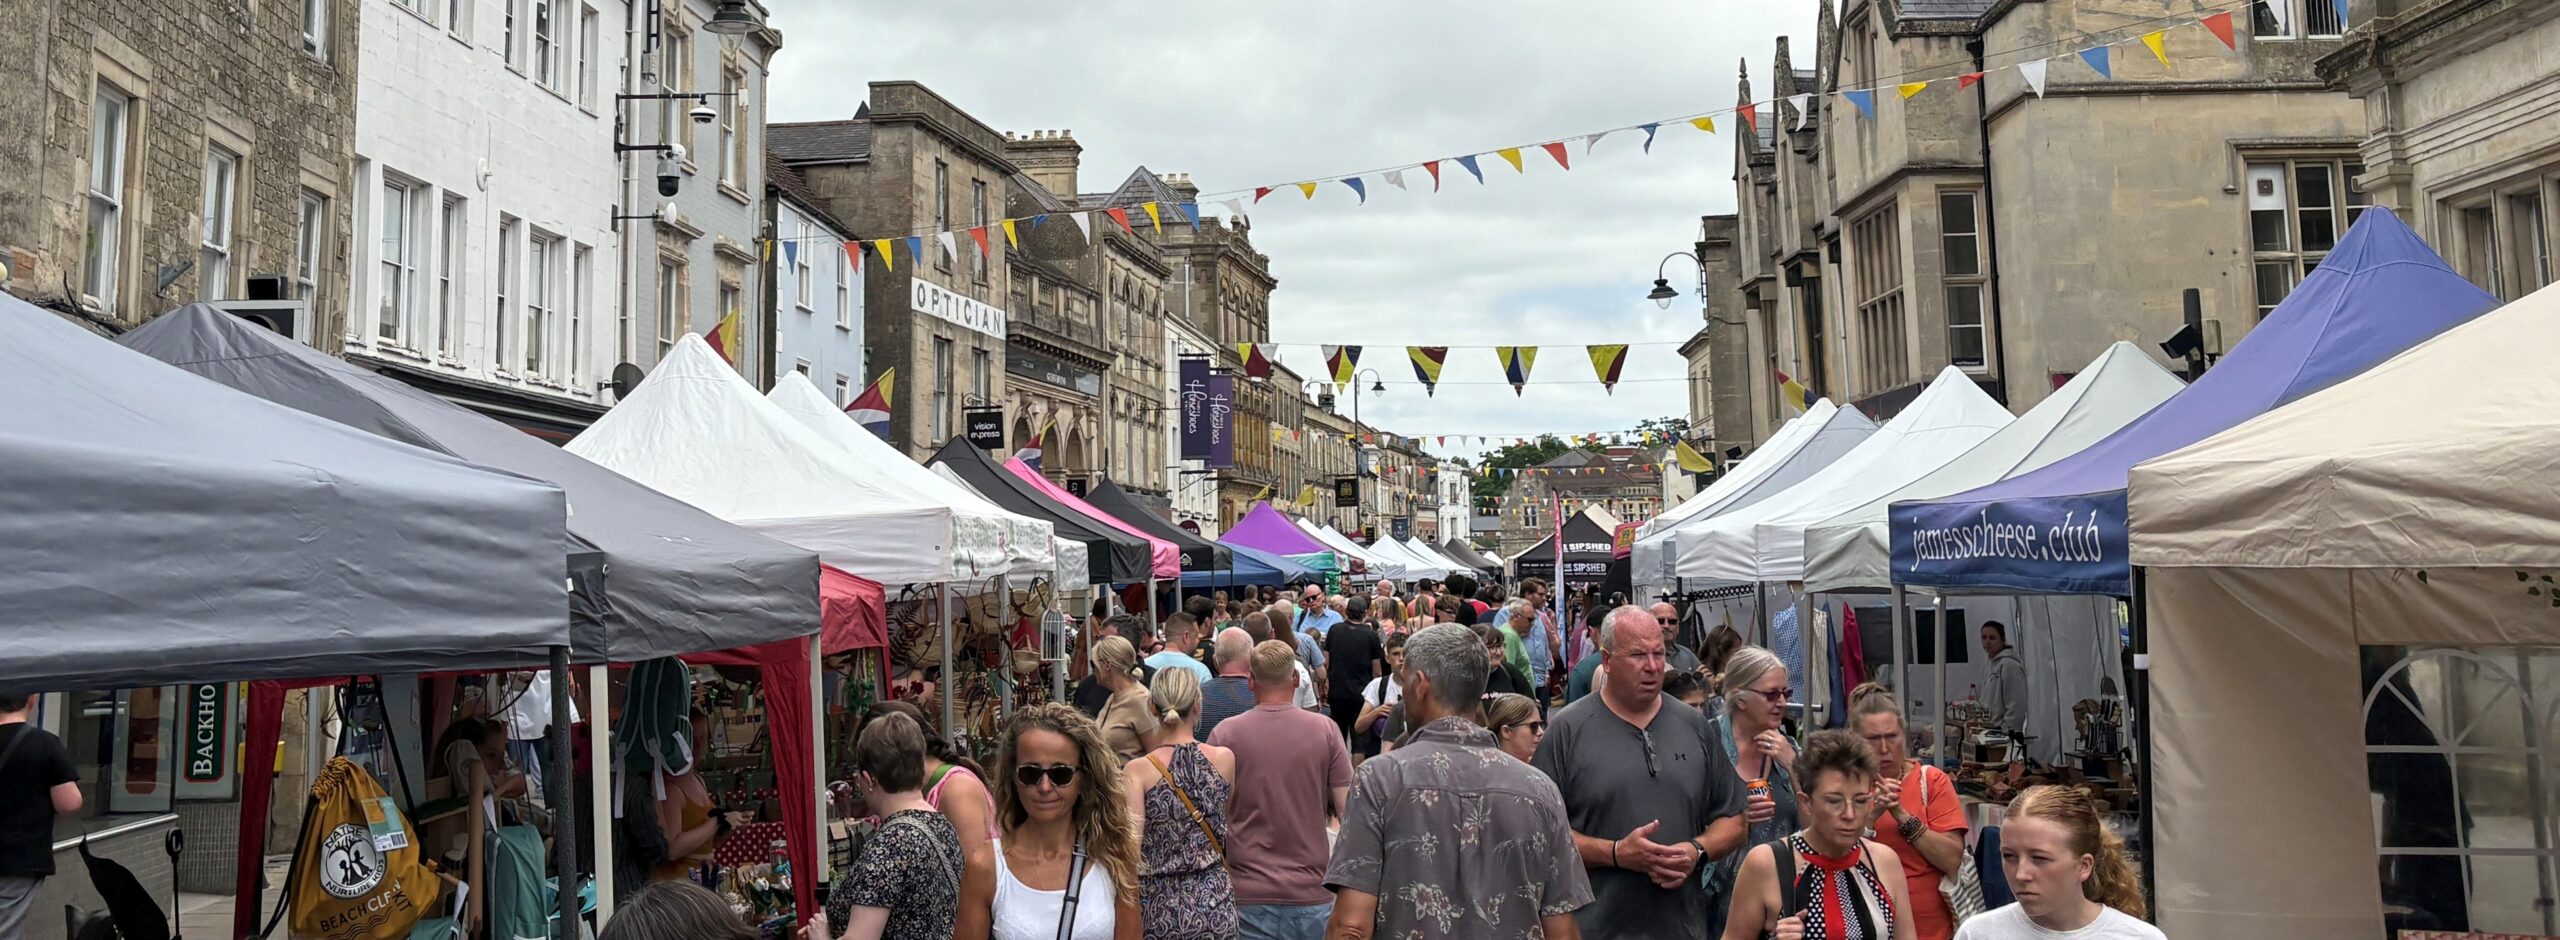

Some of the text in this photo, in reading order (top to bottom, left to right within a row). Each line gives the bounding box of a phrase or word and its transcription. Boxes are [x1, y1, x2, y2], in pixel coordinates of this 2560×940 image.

[917, 283, 1001, 334] OPTICIAN
[970, 431, 1000, 440] express
[974, 422, 996, 430] vision
[1568, 542, 1611, 551] SIPSHED
[1911, 508, 2102, 573] jamesscheese.club
[1573, 562, 1607, 572] SIPSHED
[193, 684, 216, 776] BACKHO
[326, 858, 385, 896] NURTURE KIDS
[320, 904, 368, 932] BEACH
[391, 889, 413, 912] KIT
